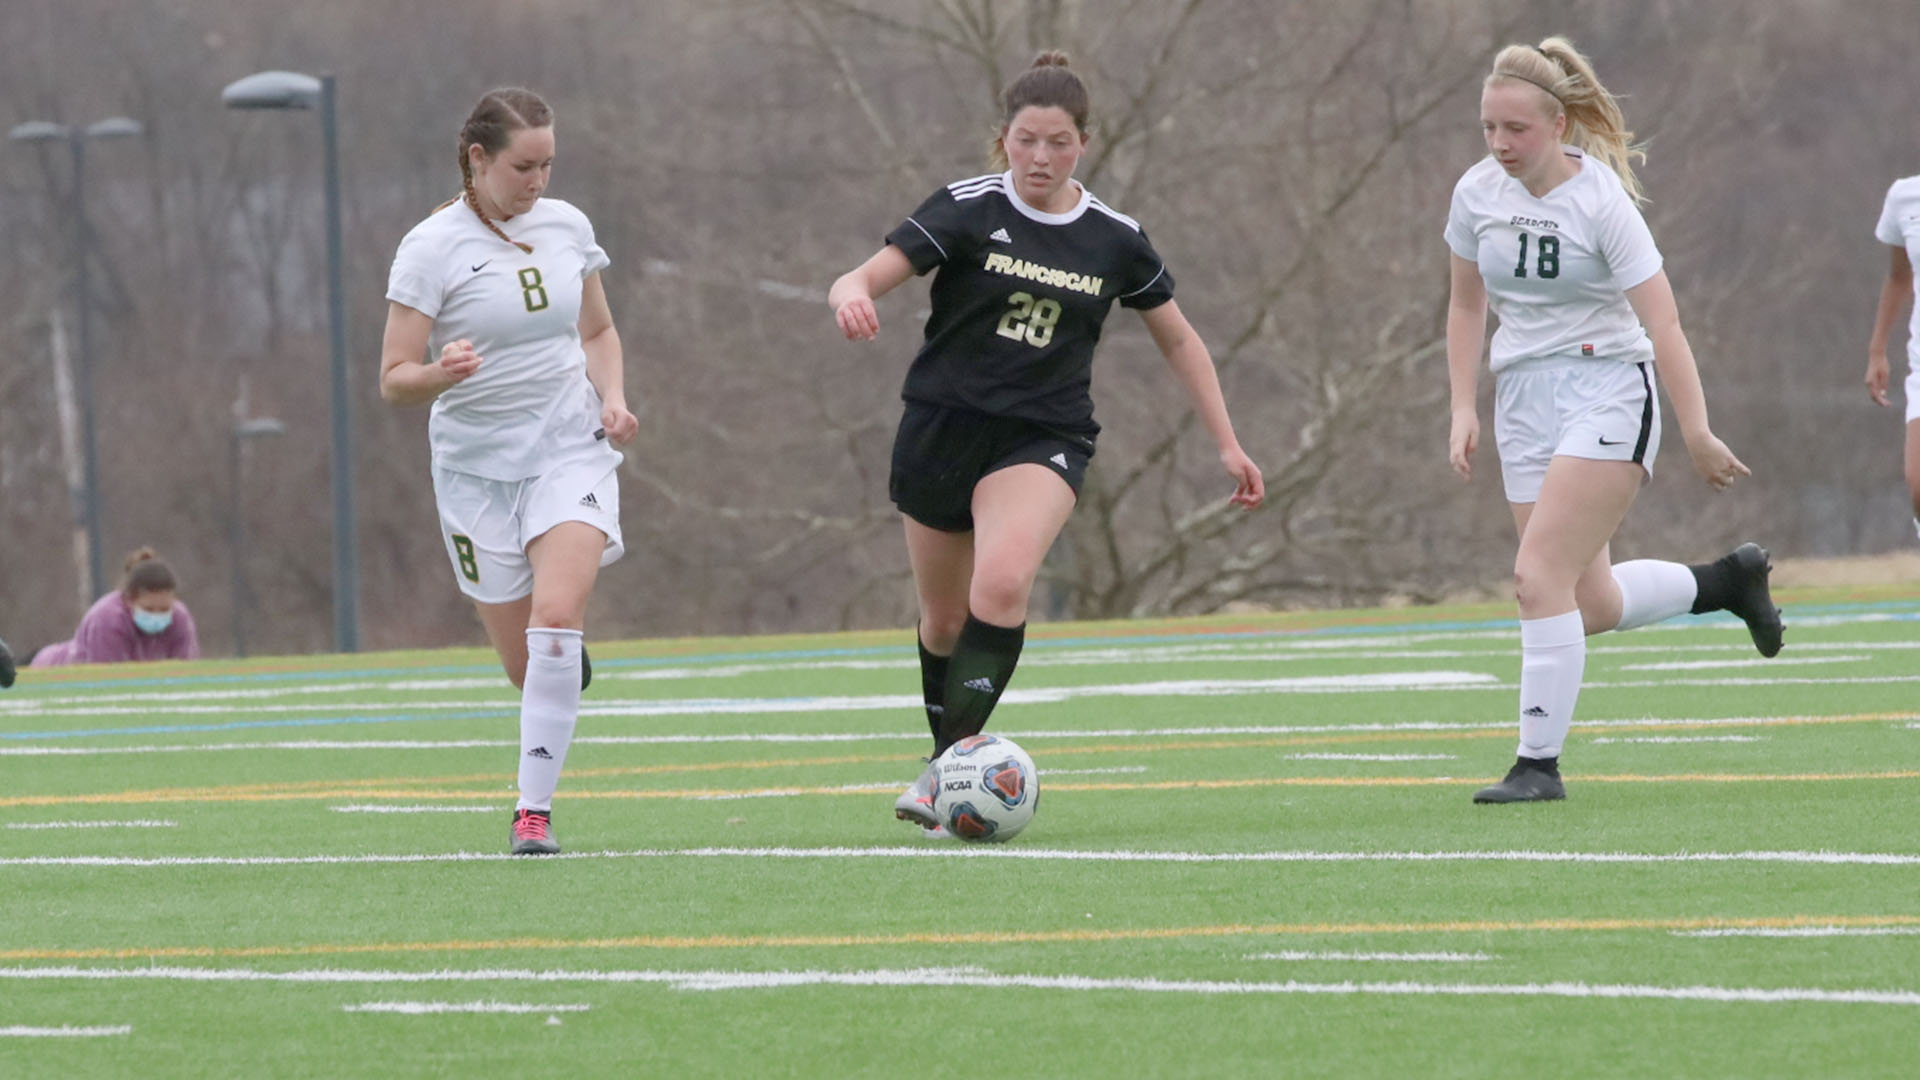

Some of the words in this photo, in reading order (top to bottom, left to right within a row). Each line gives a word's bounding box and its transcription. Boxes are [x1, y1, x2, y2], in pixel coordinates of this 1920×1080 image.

[984, 252, 1103, 296] FRANCISCAN
[1514, 232, 1560, 279] 18
[518, 267, 549, 313] 8
[996, 291, 1062, 349] 28
[451, 533, 480, 585] 8
[944, 780, 972, 792] NCAA
